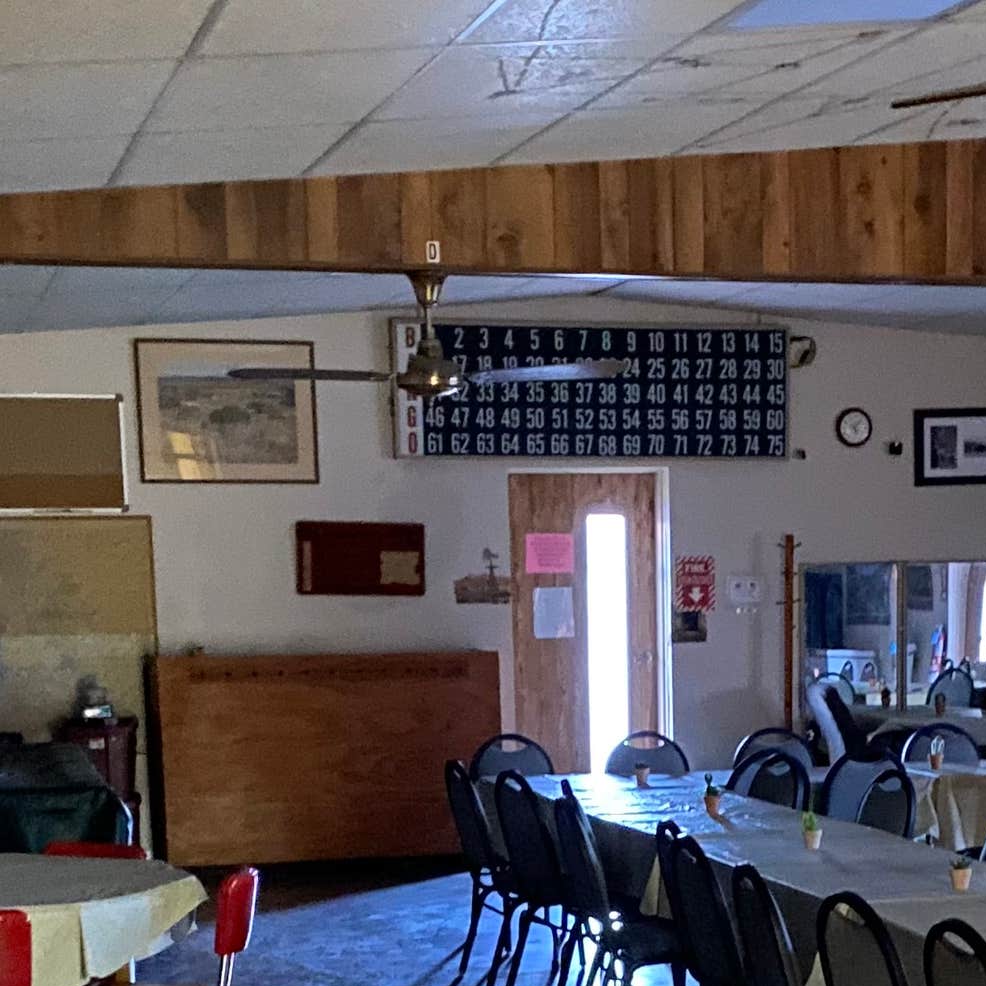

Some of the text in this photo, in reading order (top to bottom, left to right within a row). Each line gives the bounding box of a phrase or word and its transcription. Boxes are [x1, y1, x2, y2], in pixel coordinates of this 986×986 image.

[405, 327, 783, 353] B 2 3 4 5 6 7 8 9 10 11 12 13 14 15
[622, 357, 640, 378] 24
[647, 358, 665, 379] 25
[671, 358, 689, 379] 26
[695, 359, 713, 378] 27
[719, 358, 737, 378] 28
[743, 359, 761, 379] 29
[767, 359, 784, 379] 30
[476, 383, 494, 402] 33
[501, 382, 519, 402] 34
[526, 382, 544, 402] 35
[551, 382, 569, 403] 36
[575, 382, 593, 403] 37
[599, 383, 617, 404] 38
[623, 383, 640, 404] 39
[647, 384, 665, 404] 40
[673, 384, 688, 404] 41
[695, 384, 713, 404] 42
[719, 384, 737, 404] 43
[742, 384, 761, 404] 44
[766, 385, 784, 404] 45
[407, 406, 784, 430] G 46 47 48 49 50 51 52 53 54 55 56 57 58 59 60
[408, 432, 784, 456] O 61 62 63 64 65 66 67 68 69 70 71 72 73 74 75
